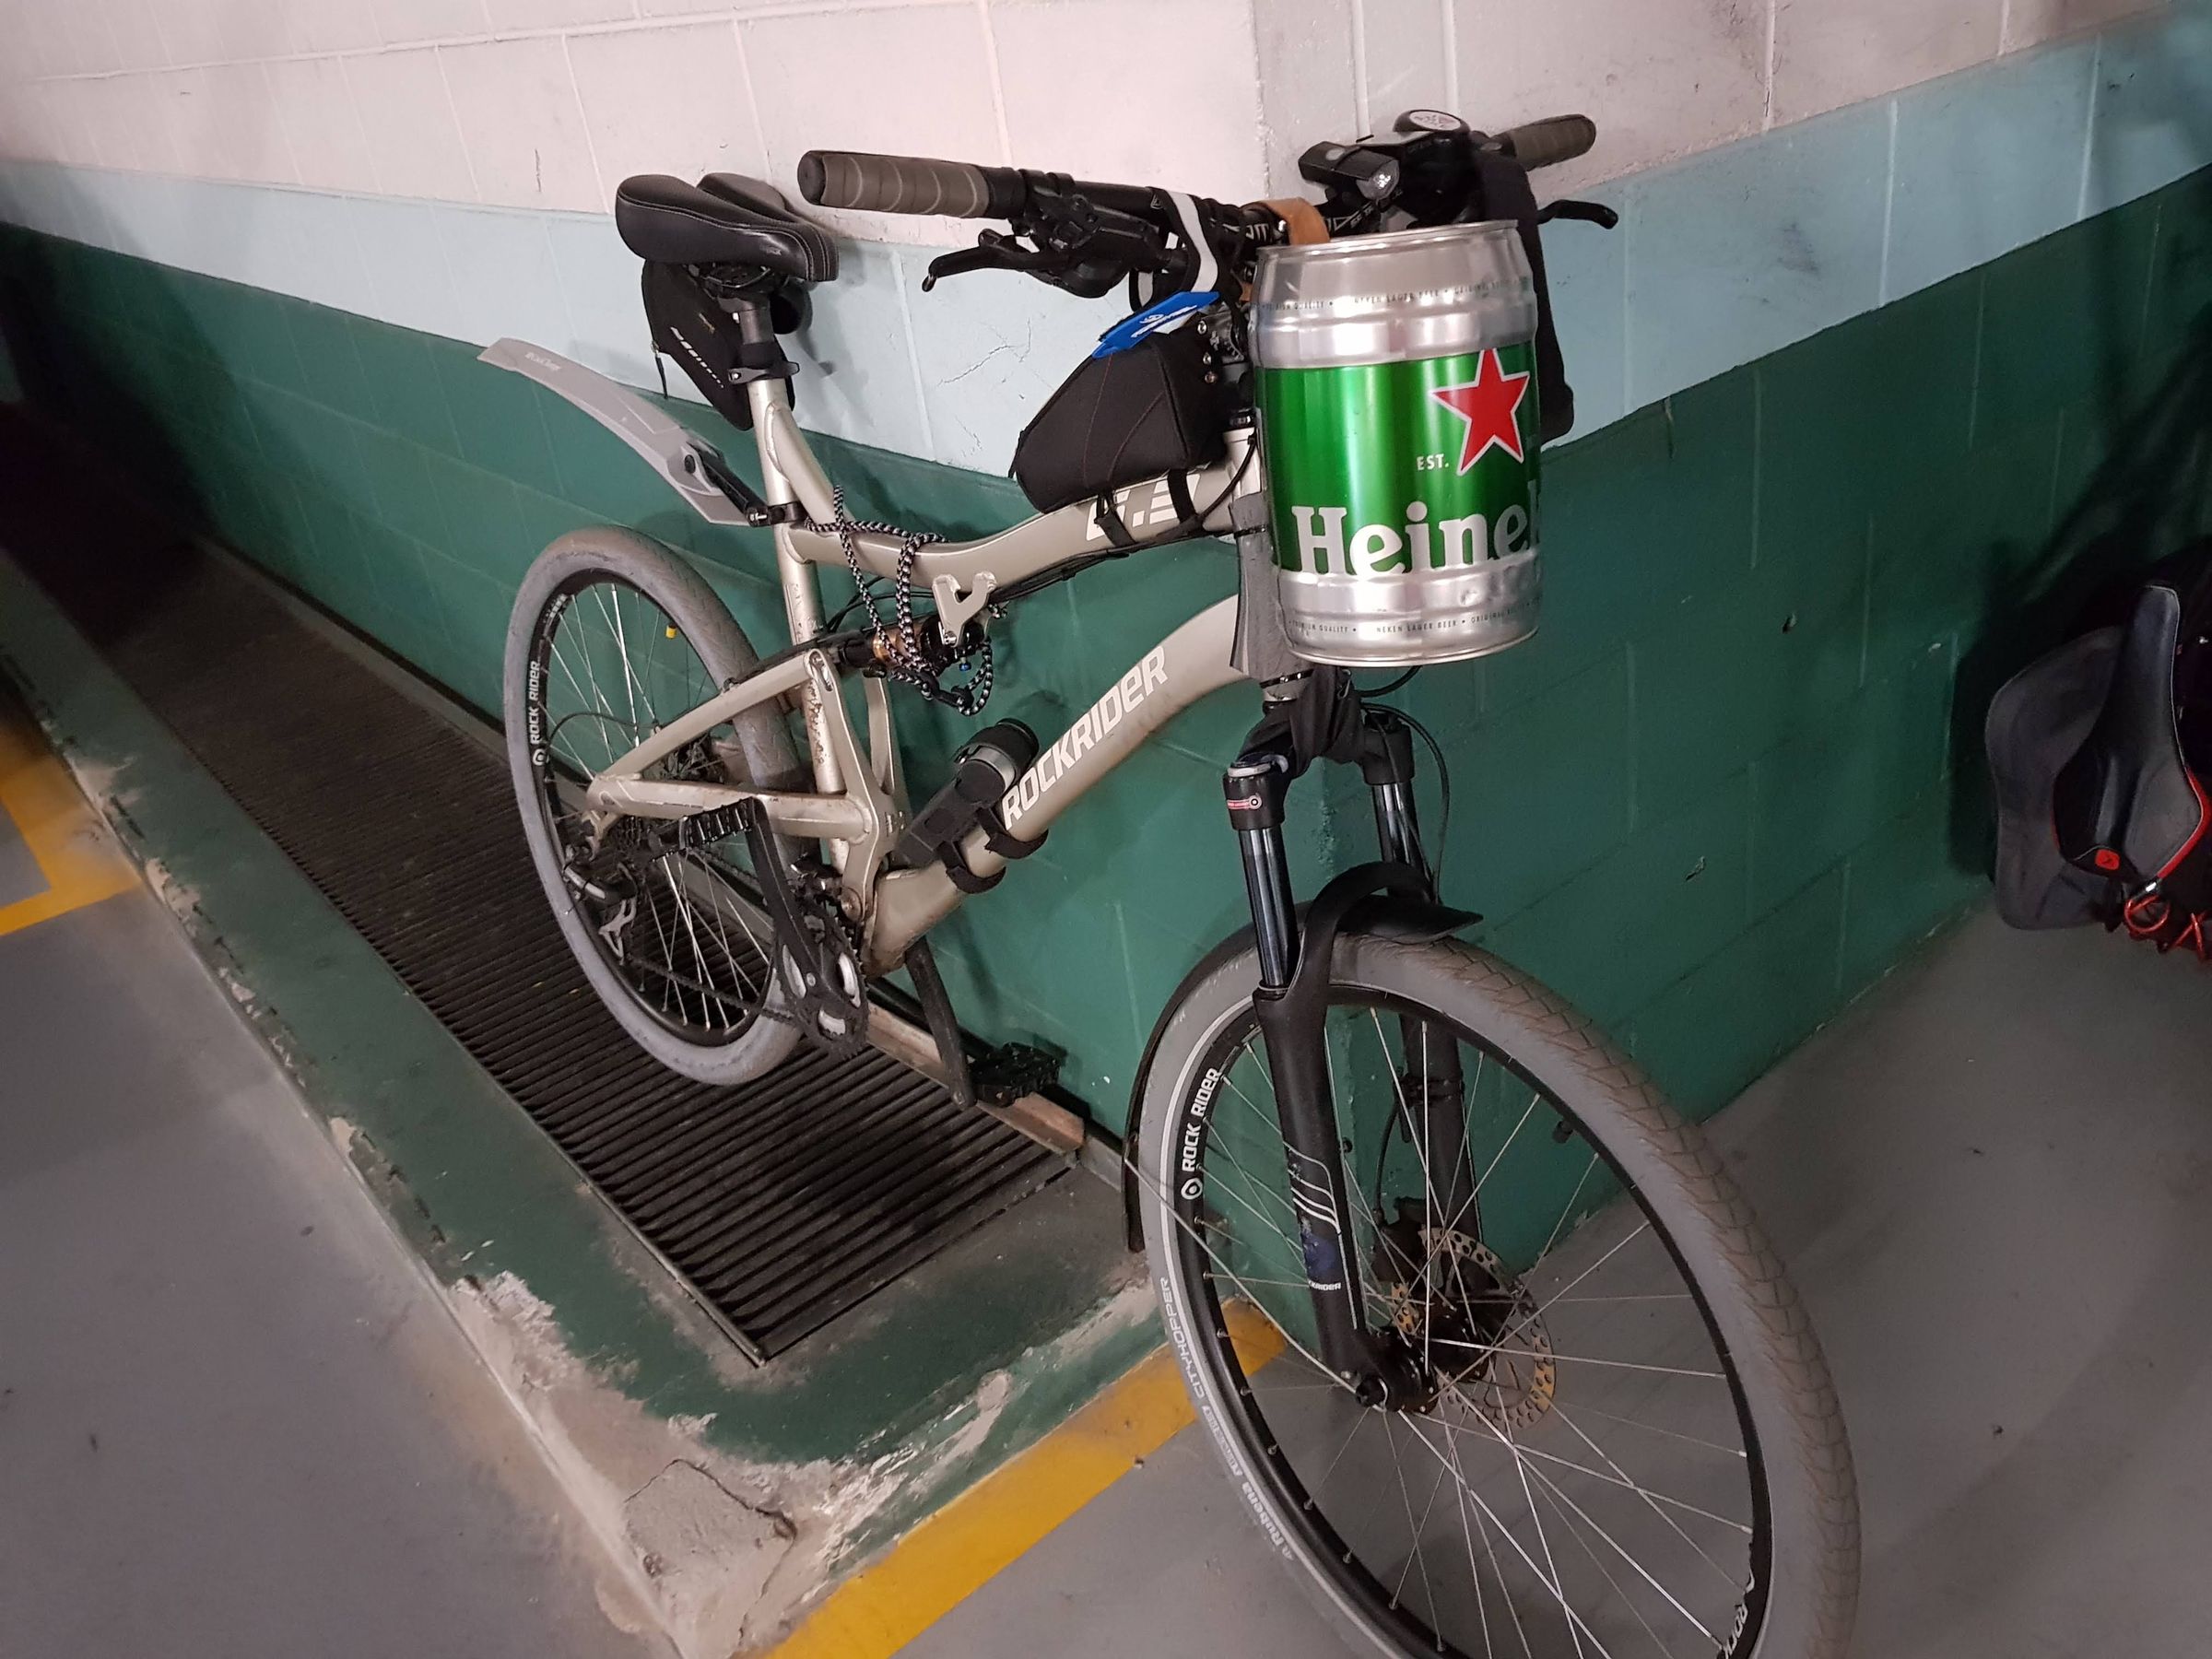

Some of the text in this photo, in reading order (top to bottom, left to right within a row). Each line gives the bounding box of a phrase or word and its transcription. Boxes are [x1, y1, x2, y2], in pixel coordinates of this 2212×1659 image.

[1416, 453, 1450, 471] EST.
[528, 660, 542, 746] ROCK RIDER
[1002, 645, 1169, 830] ROCKRIDER
[1182, 1067, 1223, 1172] ROCK RIDER
[1159, 1277, 1206, 1400] CITYHOPPER
